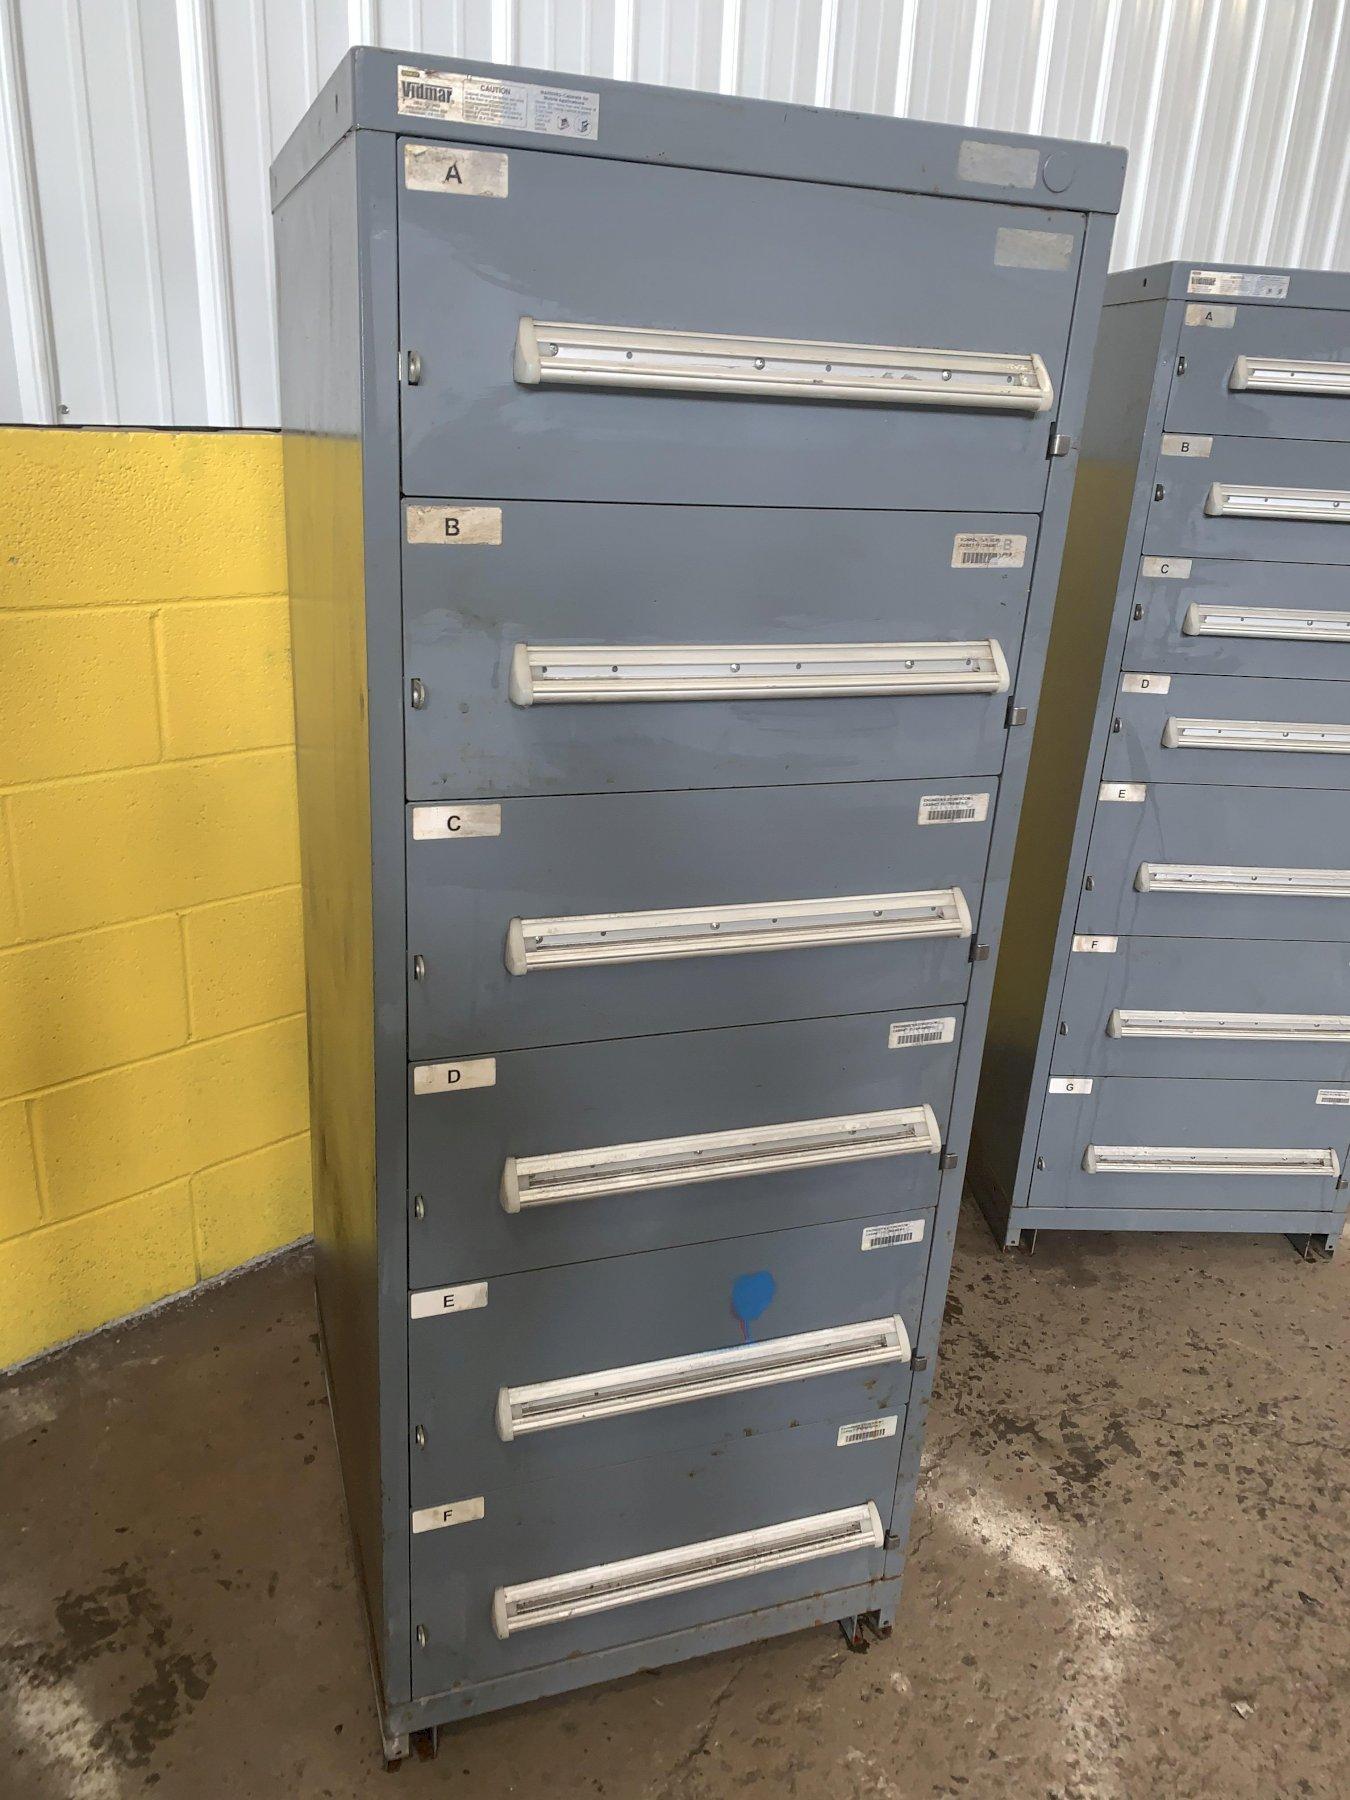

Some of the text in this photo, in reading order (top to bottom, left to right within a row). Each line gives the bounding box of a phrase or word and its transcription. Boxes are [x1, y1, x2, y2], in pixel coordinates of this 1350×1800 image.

[401, 81, 453, 103] Vidmar
[480, 84, 511, 95] CAUTION
[444, 161, 462, 184] A
[1205, 311, 1213, 321] A
[1181, 442, 1190, 452] B
[445, 518, 459, 536] B
[1161, 564, 1170, 574] C
[1142, 680, 1150, 689] D
[1118, 790, 1126, 798] E
[447, 815, 460, 831] C
[1091, 940, 1099, 949] F
[447, 1070, 460, 1084] D
[1066, 1083, 1073, 1091] G
[444, 1295, 454, 1308] E
[443, 1510, 452, 1522] F
